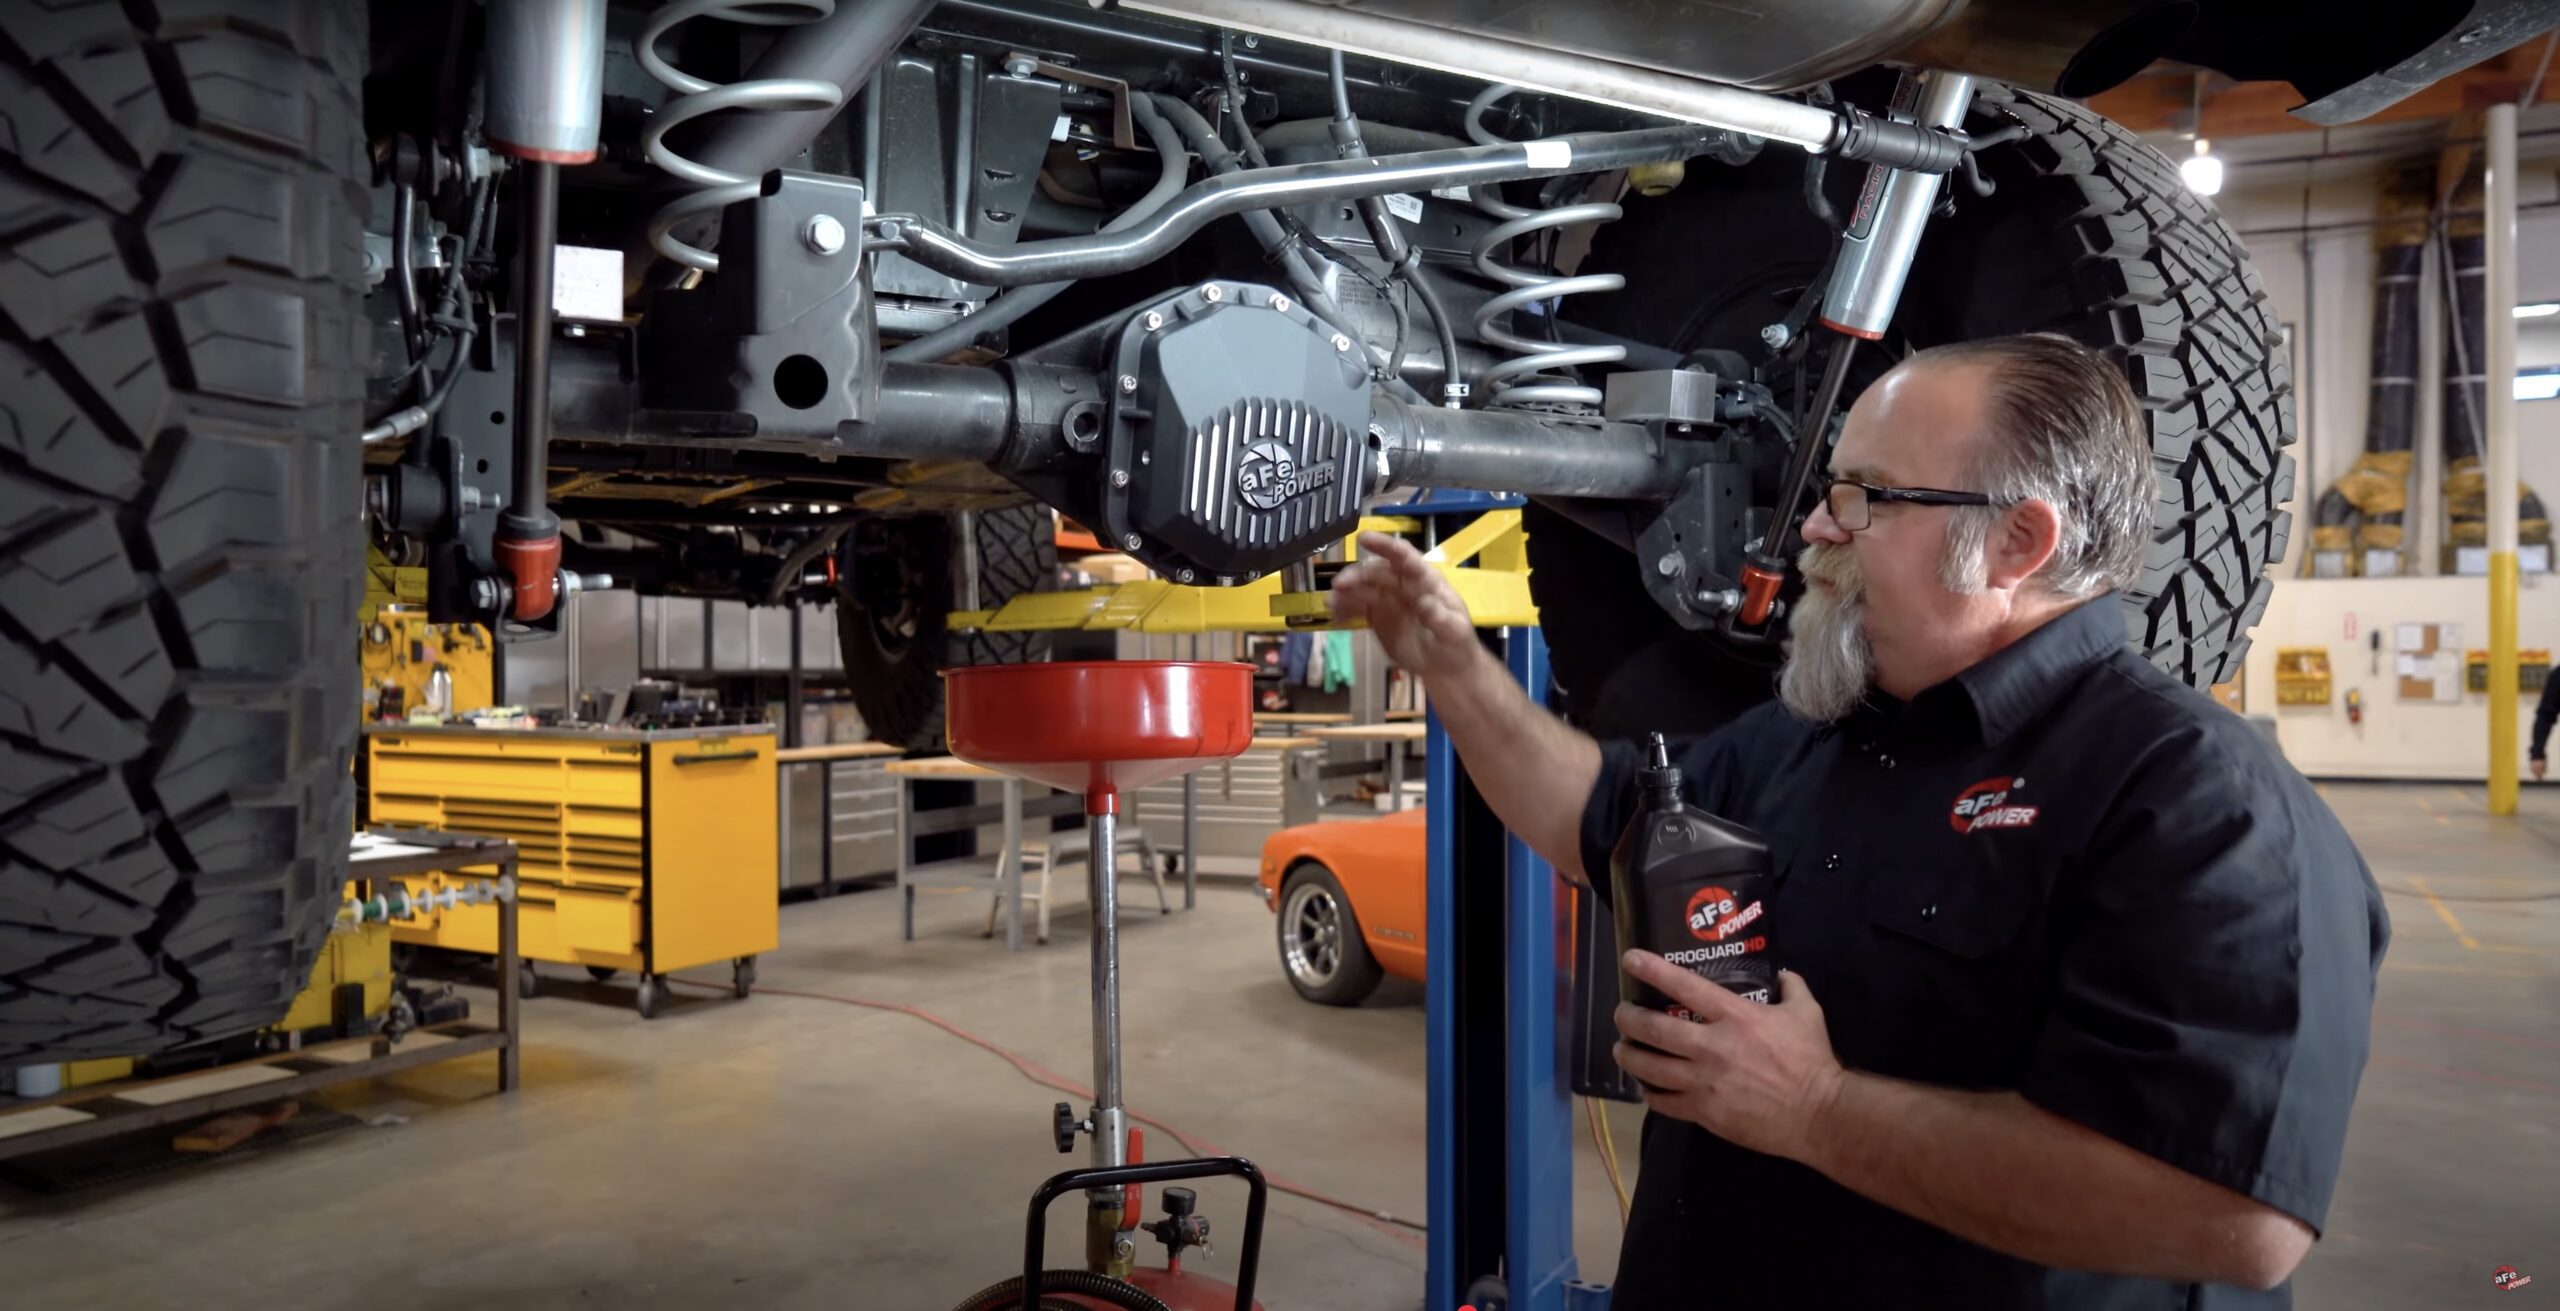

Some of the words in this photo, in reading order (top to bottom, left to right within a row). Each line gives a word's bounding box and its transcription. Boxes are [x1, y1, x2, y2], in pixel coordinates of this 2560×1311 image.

[1858, 164, 1885, 220] RACIN
[1240, 459, 1294, 491] aFe
[1272, 464, 1335, 503] POWER
[1953, 790, 2008, 815] aFe
[1967, 807, 2036, 833] POWER
[1689, 898, 1735, 930] aFe
[1718, 900, 1763, 940] POWER
